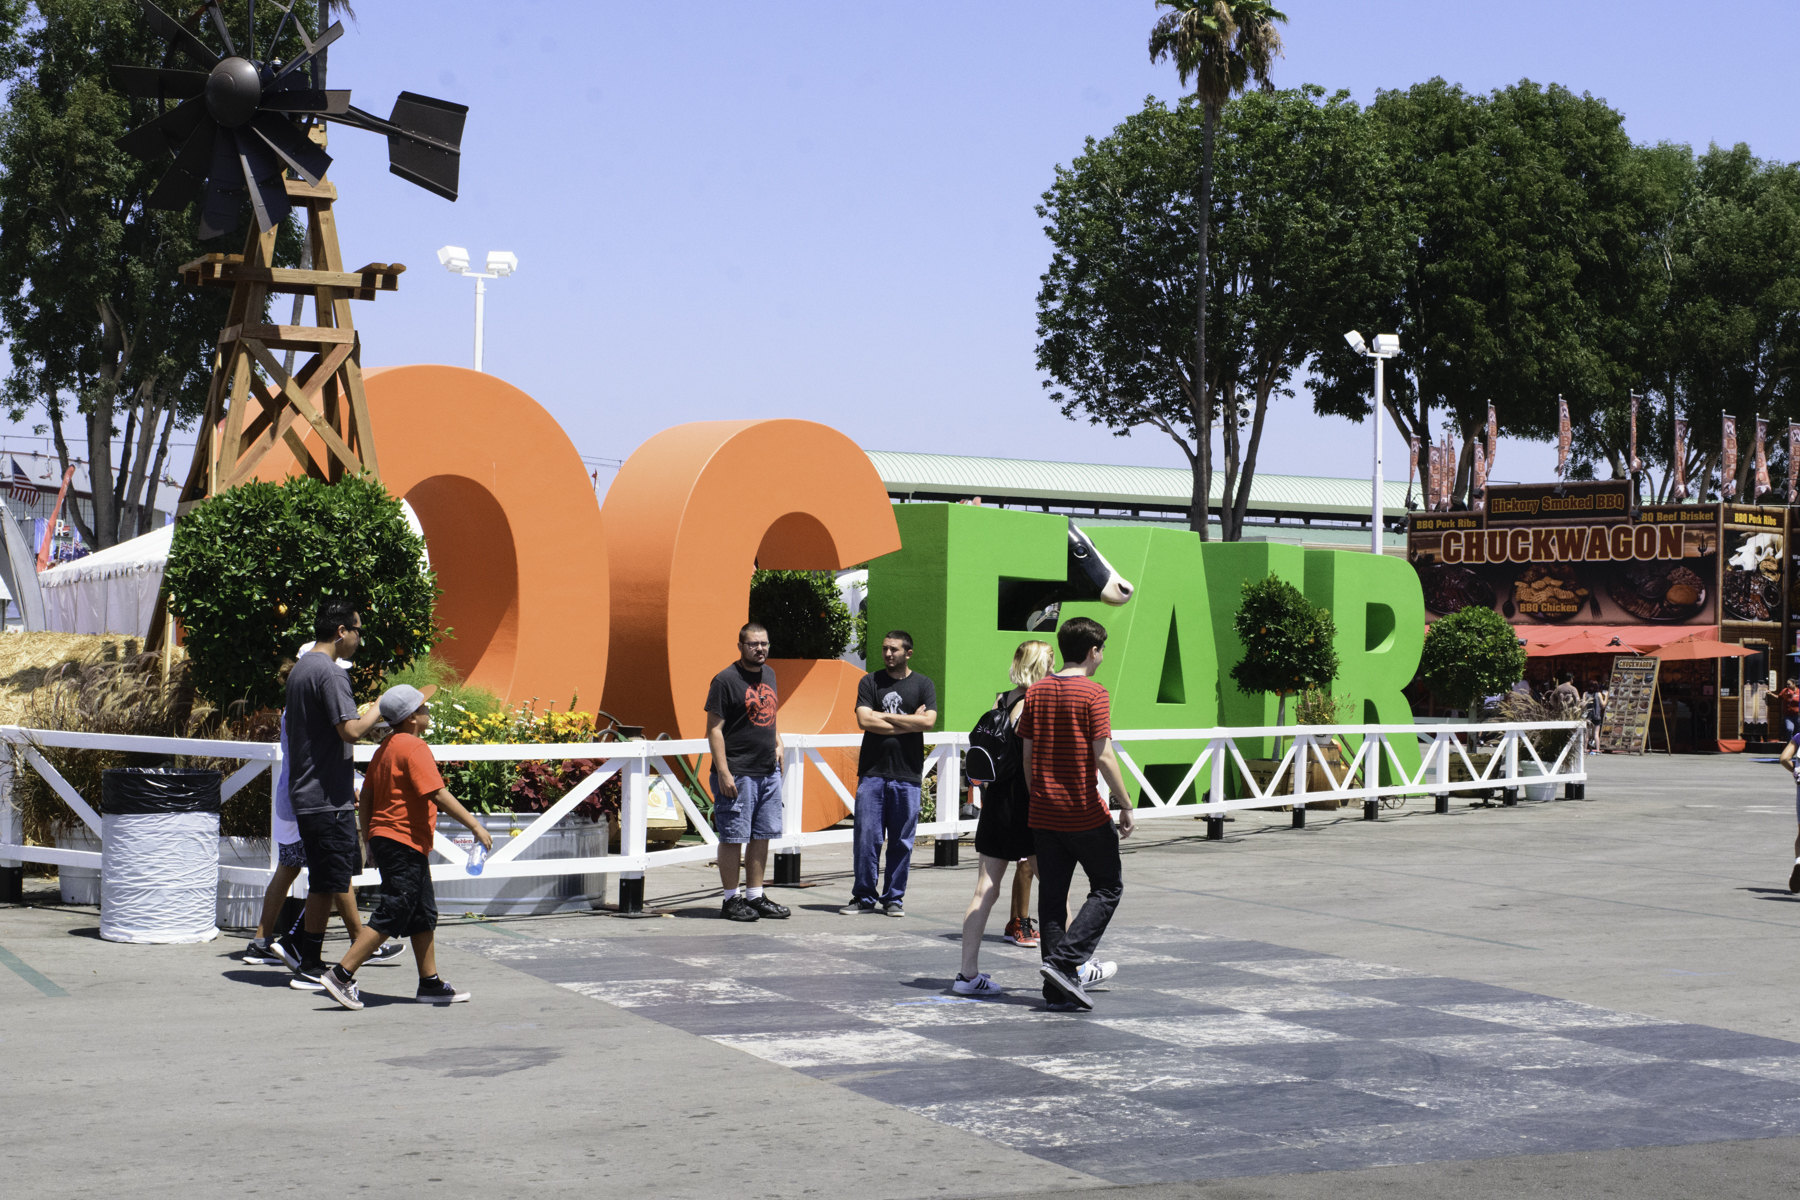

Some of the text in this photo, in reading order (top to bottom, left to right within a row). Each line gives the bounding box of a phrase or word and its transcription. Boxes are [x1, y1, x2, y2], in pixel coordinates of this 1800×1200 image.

[1491, 493, 1625, 515] Hickory Smoked BBQ
[1635, 511, 1714, 522] BQ Beef Brisket
[1734, 512, 1777, 526] BBQ Pork Ribs
[1416, 518, 1477, 530] BBQ Pork Ribs
[1442, 525, 1684, 564] CHUCKWAGON
[200, 364, 1427, 832] OC FAIR
[1519, 602, 1578, 614] BBQ Chicken
